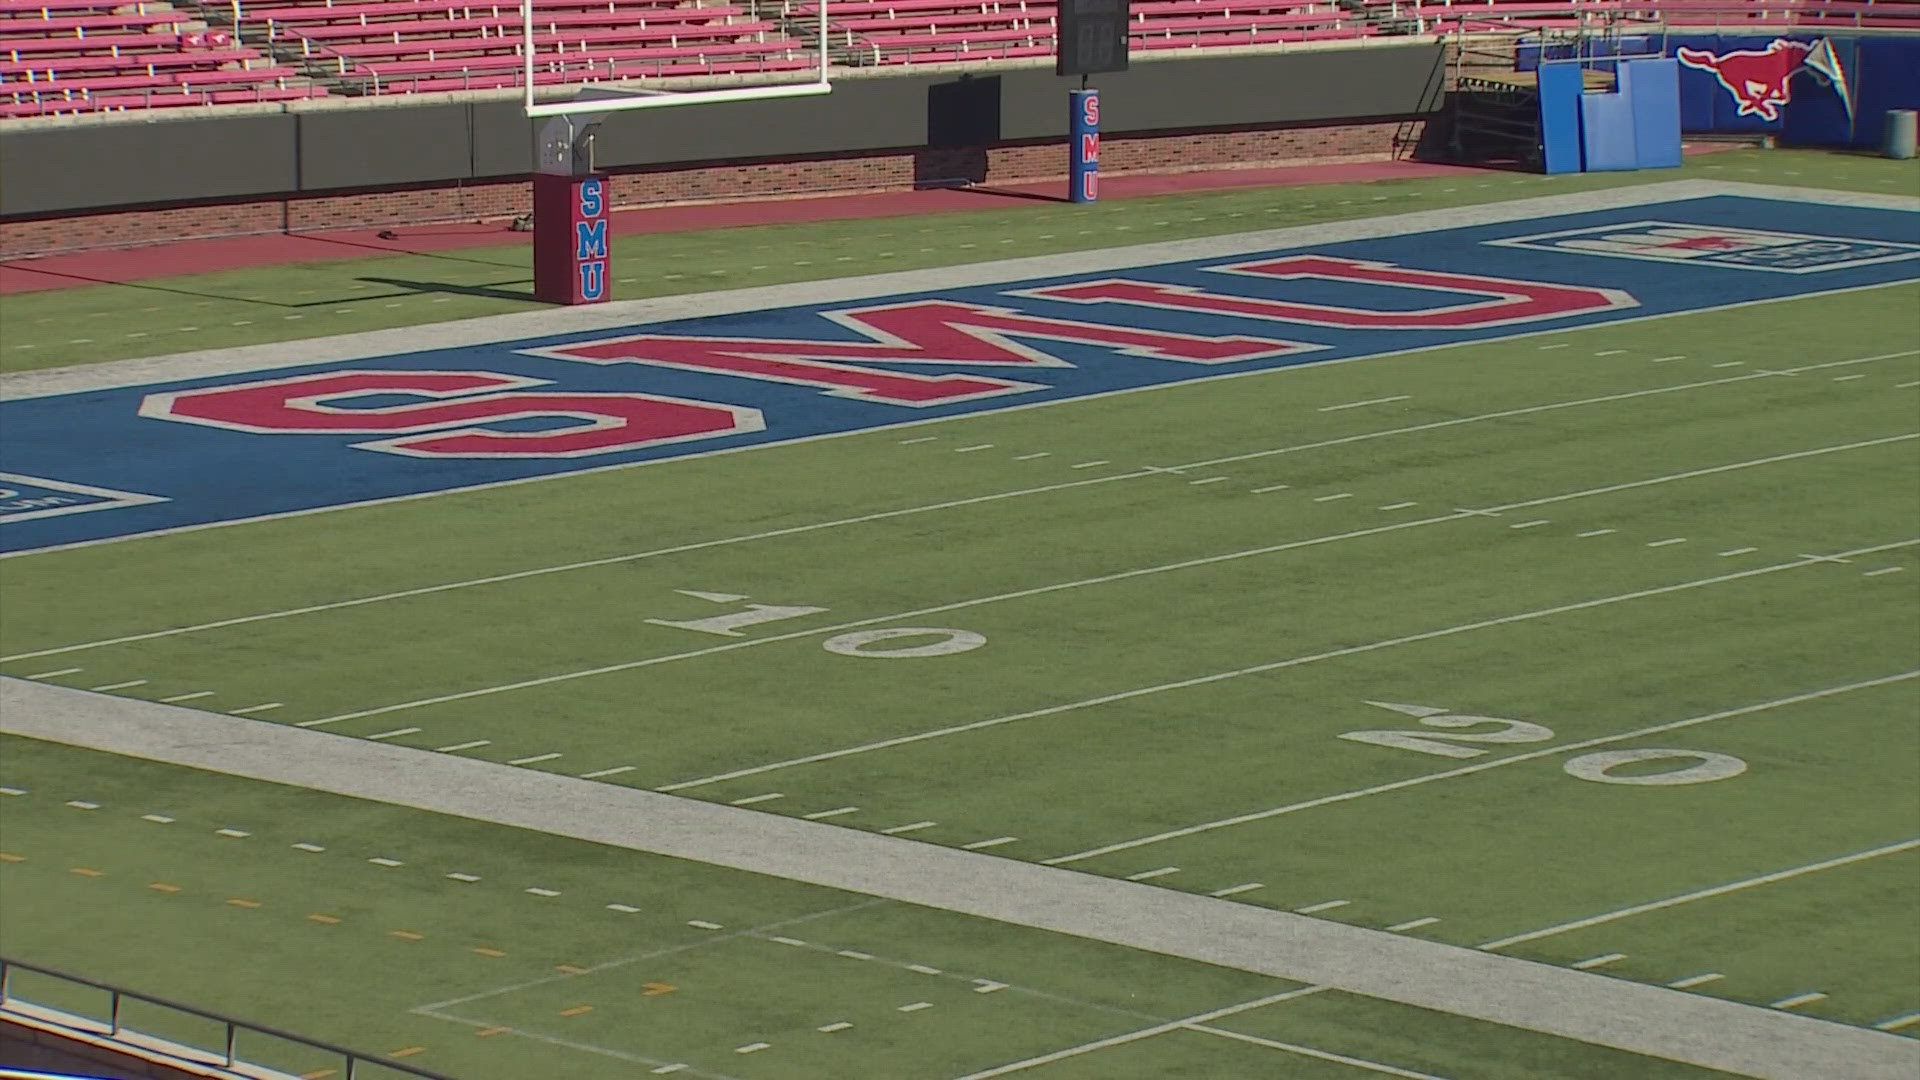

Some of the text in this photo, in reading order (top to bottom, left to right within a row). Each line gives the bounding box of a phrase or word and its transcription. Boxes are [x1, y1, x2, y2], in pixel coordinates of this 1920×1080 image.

[1082, 96, 1099, 200] SMU
[576, 178, 607, 300] SMU
[138, 254, 1641, 460] SMU
[644, 603, 987, 658] 10
[1337, 714, 1747, 786] 20
